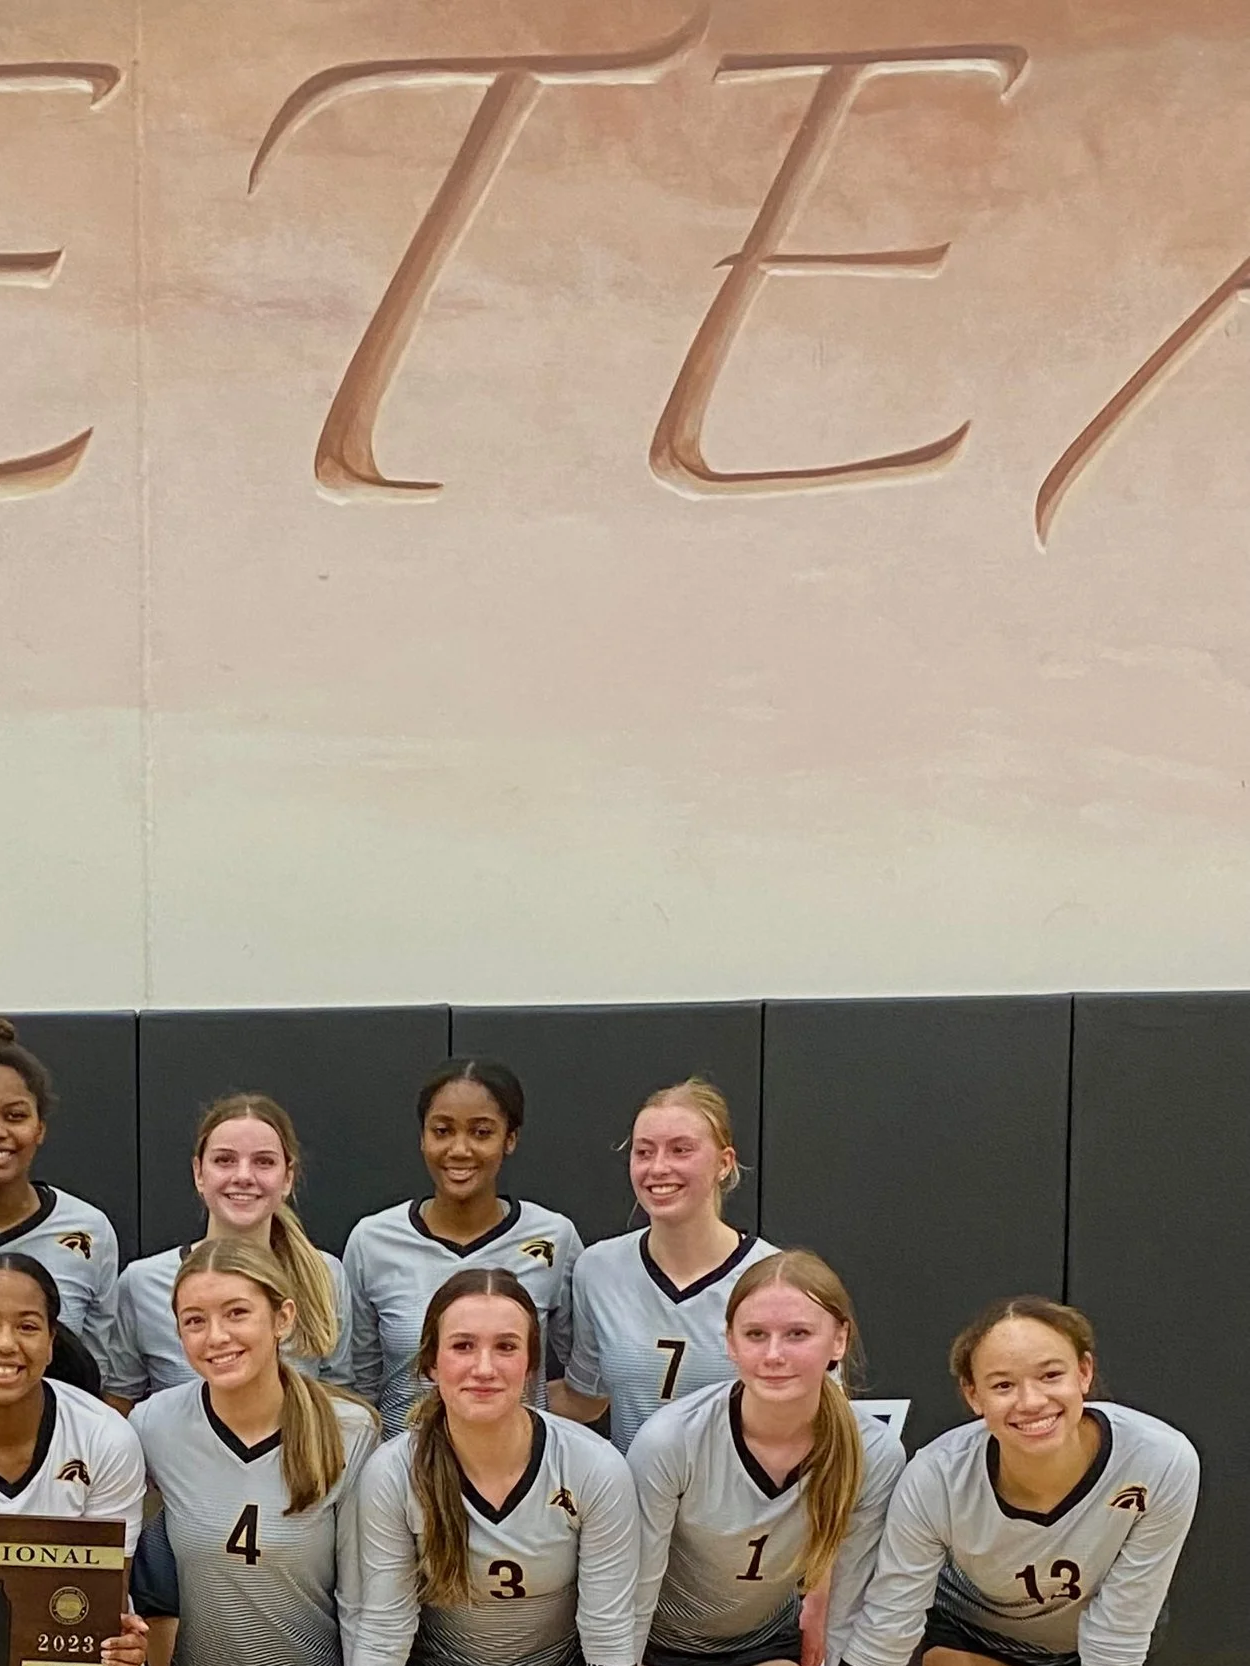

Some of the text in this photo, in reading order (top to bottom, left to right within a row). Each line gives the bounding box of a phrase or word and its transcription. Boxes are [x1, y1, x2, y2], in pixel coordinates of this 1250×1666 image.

[655, 1340, 687, 1400] 7
[224, 1503, 261, 1565] 4
[488, 1560, 526, 1600] 3
[735, 1535, 769, 1582] 1
[1014, 1560, 1082, 1604] 13
[37, 1634, 95, 1653] 2023
